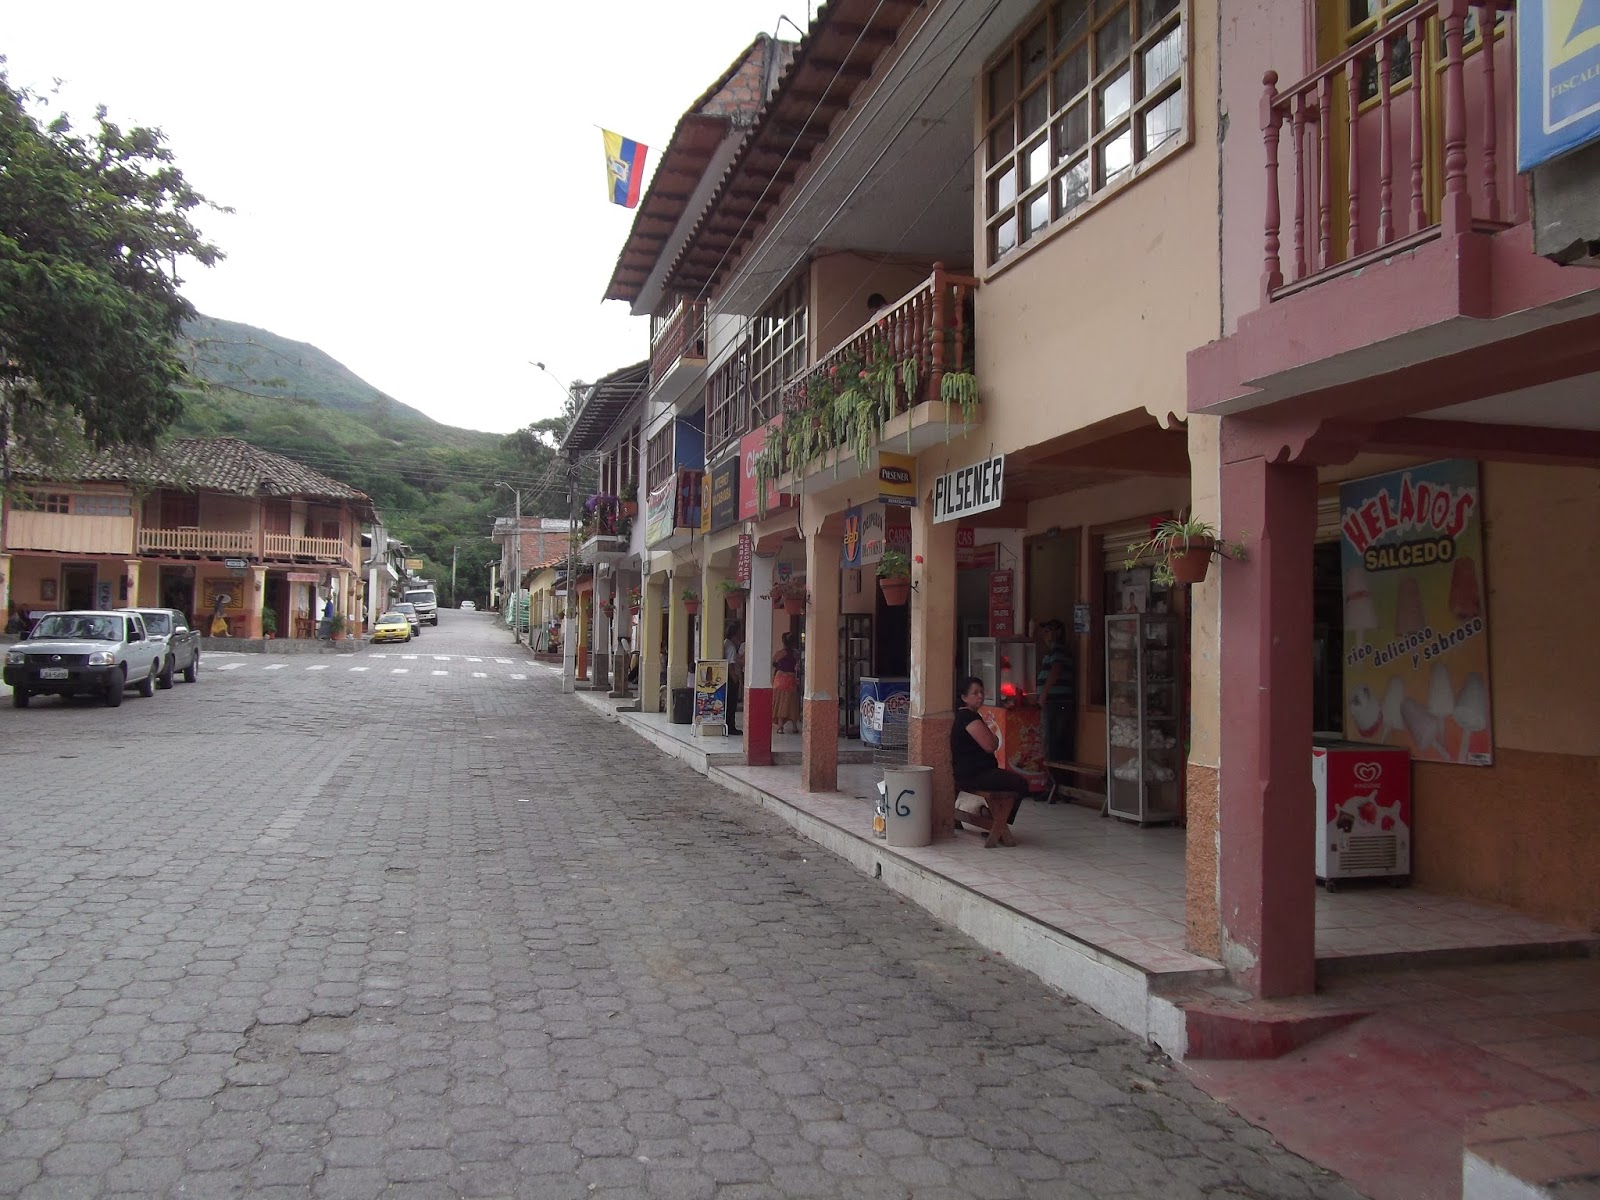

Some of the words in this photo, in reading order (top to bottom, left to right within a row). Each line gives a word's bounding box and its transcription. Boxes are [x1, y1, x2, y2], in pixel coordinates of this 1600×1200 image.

[882, 468, 909, 482] PILSENER
[934, 457, 1002, 517] PILSENER
[1342, 478, 1475, 554] HELADOS
[843, 532, 858, 545] 220
[1365, 540, 1452, 570] SALCEDO
[1346, 644, 1372, 665] rico
[1374, 627, 1433, 667] delicioso
[1412, 654, 1419, 669] y
[1424, 618, 1482, 660] sabroso
